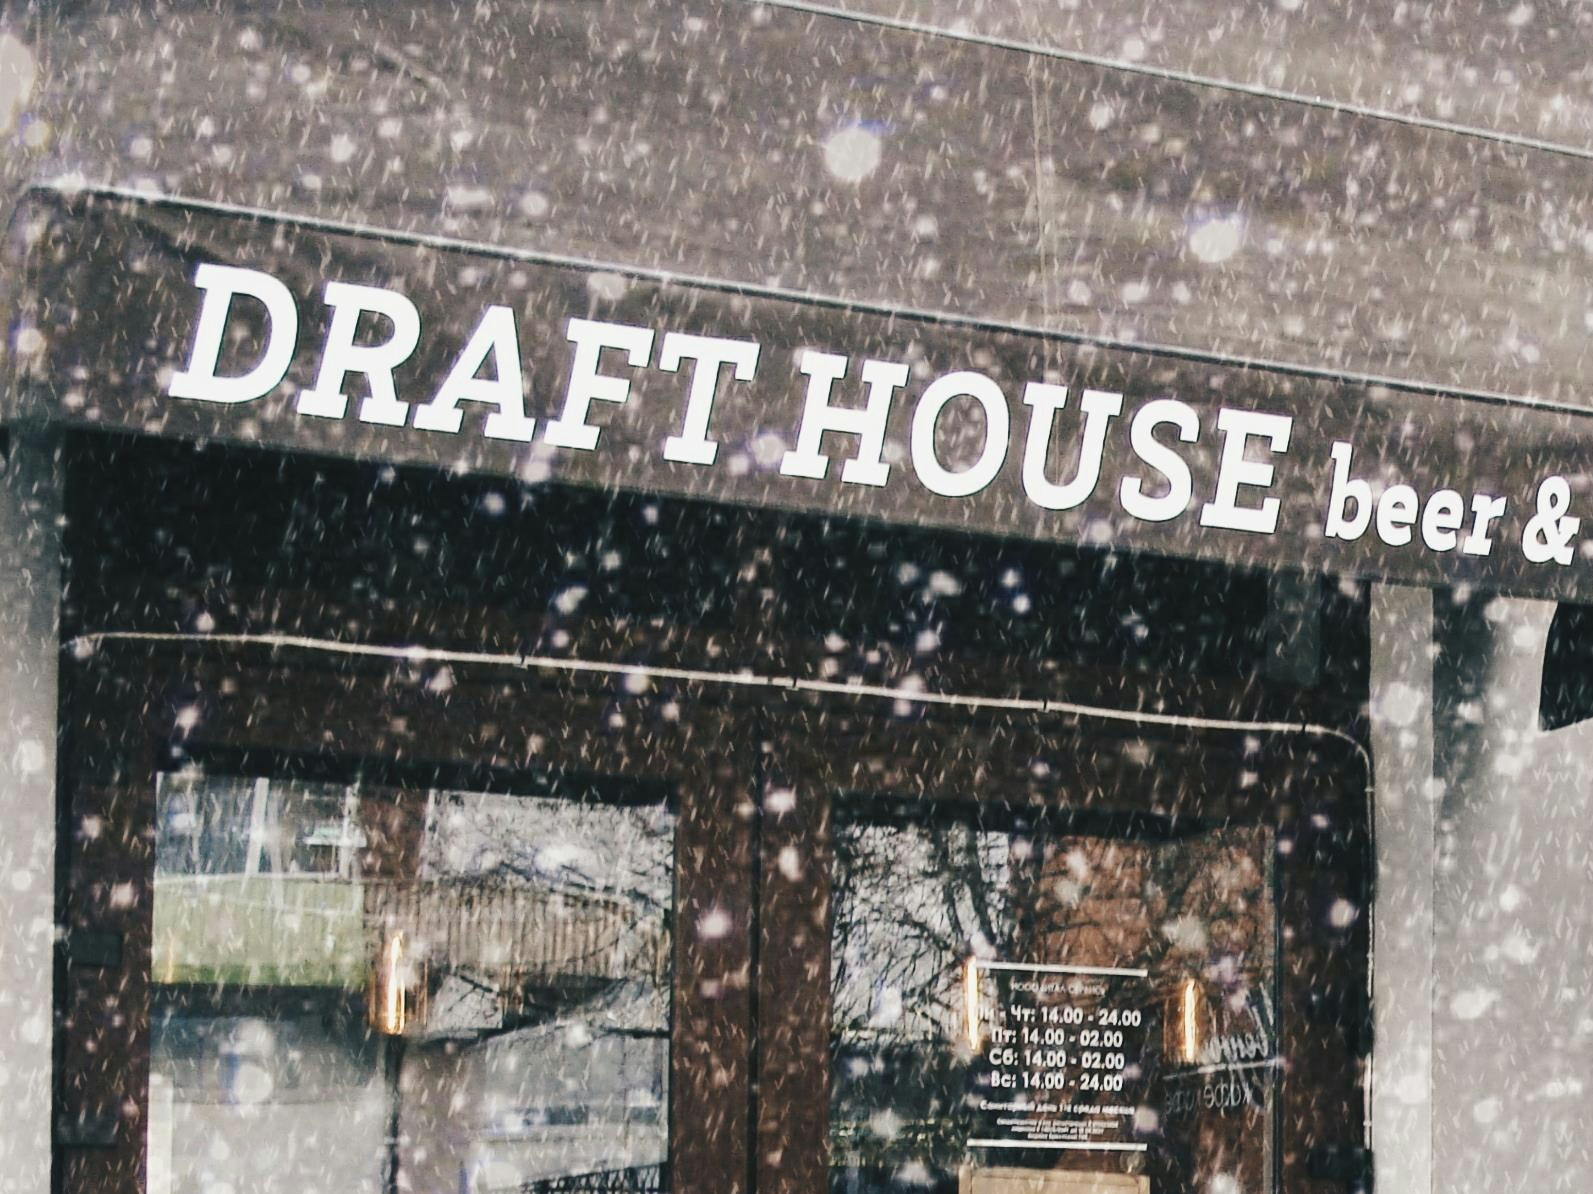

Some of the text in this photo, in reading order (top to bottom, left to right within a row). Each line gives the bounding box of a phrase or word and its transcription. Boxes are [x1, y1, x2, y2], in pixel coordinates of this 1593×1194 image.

[168, 262, 761, 466] DRAFT
[779, 350, 1292, 535] HOUSE
[1324, 442, 1508, 556] beer
[1522, 475, 1579, 566] &
[1011, 1004, 1036, 1023] Чт:
[1041, 1007, 1083, 1025] 14.00
[1098, 1009, 1141, 1027] 24.00
[991, 1028, 1016, 1044] Пт:
[1022, 1027, 1064, 1046] 14.00
[1080, 1030, 1123, 1048] 02.00
[989, 1048, 1018, 1066] Сб:
[1024, 1050, 1066, 1067] 14.00
[1081, 1052, 1125, 1070] 02.00
[991, 1070, 1016, 1088] Вс:
[1022, 1071, 1064, 1090] 14.00
[1080, 1073, 1123, 1091] 24.00
